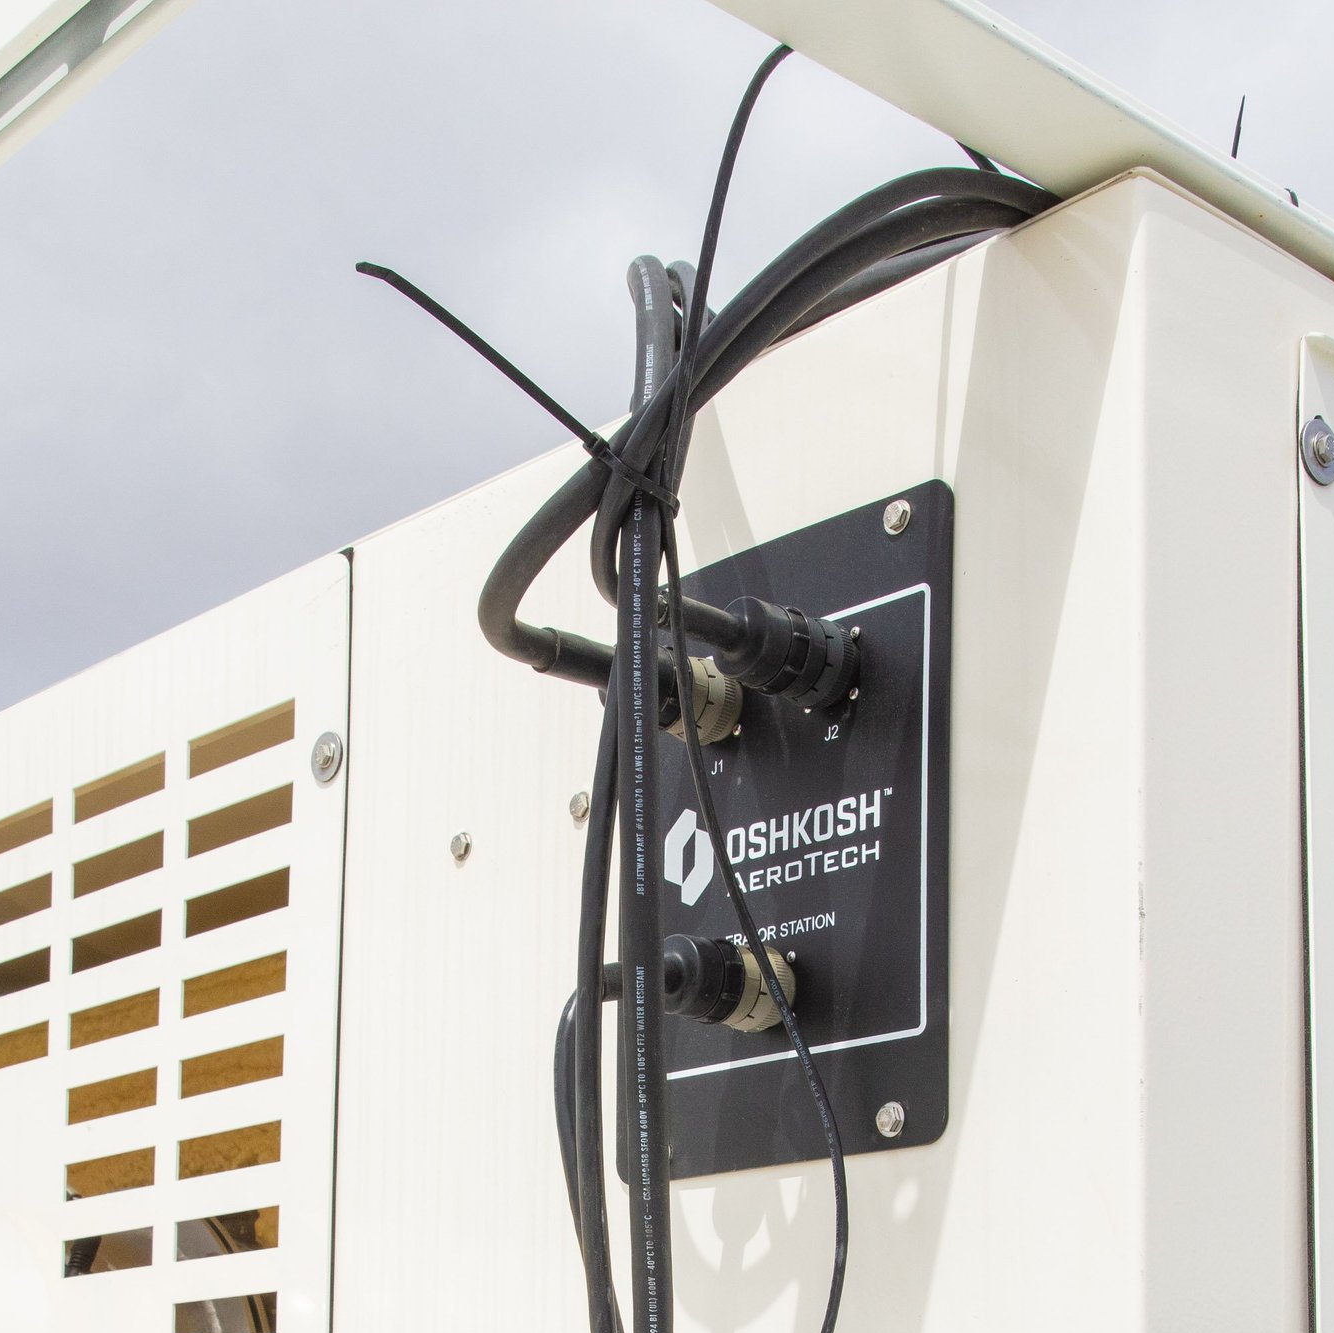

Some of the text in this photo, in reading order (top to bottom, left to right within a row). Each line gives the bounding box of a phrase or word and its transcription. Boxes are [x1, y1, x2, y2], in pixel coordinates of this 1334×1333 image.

[634, 507, 642, 520] CSA
[633, 559, 641, 568] TO
[633, 594, 641, 611] 600V
[633, 614, 642, 629] (UL)
[633, 640, 642, 669] E46194
[633, 670, 642, 691] SEOW
[634, 692, 642, 710] 10/C
[824, 725, 839, 741] J2
[635, 755, 643, 772] AWG
[711, 759, 724, 775] J1
[635, 775, 643, 783] 16
[635, 788, 644, 831] #4170670
[727, 789, 881, 864] OSHKOSH
[636, 833, 644, 853] PART
[636, 854, 644, 881] JETWAY
[636, 883, 644, 896] JBT
[779, 911, 836, 937] STATION
[636, 965, 645, 1004] RESISTANT
[636, 1007, 645, 1030] WATER
[638, 1073, 645, 1082] TO
[639, 1110, 647, 1129] 600V
[646, 1240, 654, 1249] TO
[648, 1277, 656, 1295] 600V
[649, 1297, 658, 1312] (UL)
